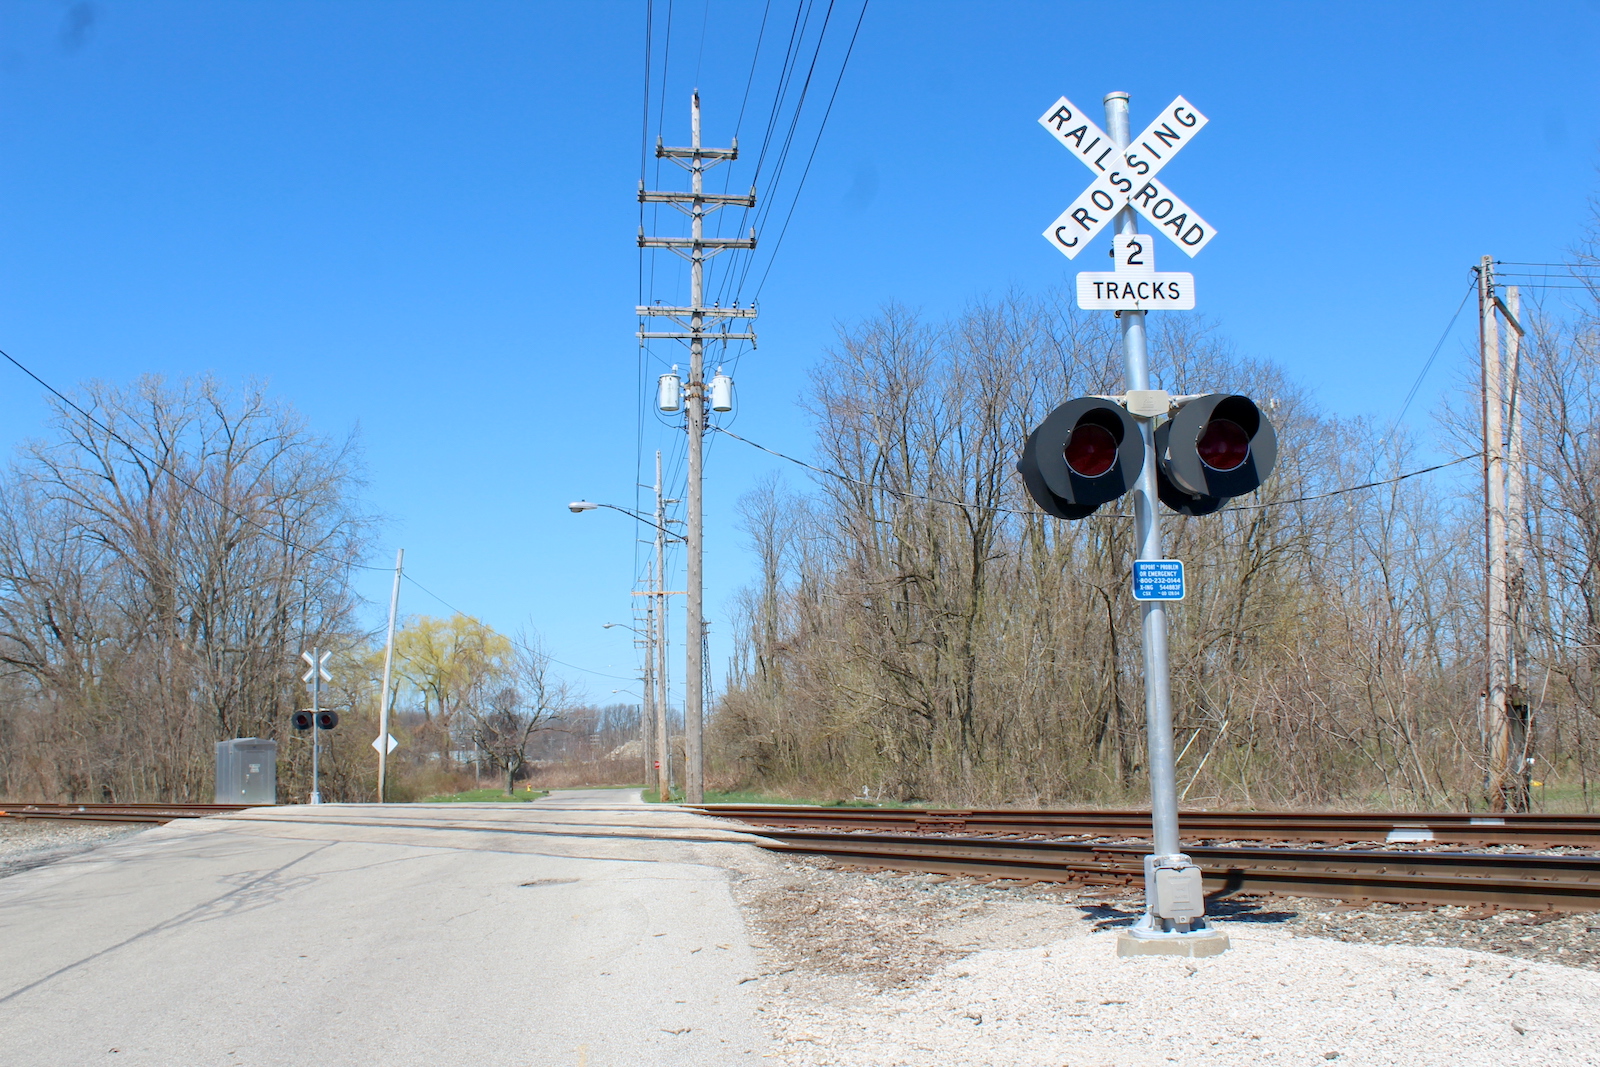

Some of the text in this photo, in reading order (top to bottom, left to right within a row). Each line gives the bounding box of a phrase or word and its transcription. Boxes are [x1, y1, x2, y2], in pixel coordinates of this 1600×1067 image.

[1047, 105, 1204, 247] RAIL ROAD
[1054, 106, 1197, 248] CROSSING
[1092, 282, 1180, 300] TRACKS
[1126, 241, 1144, 265] 2
